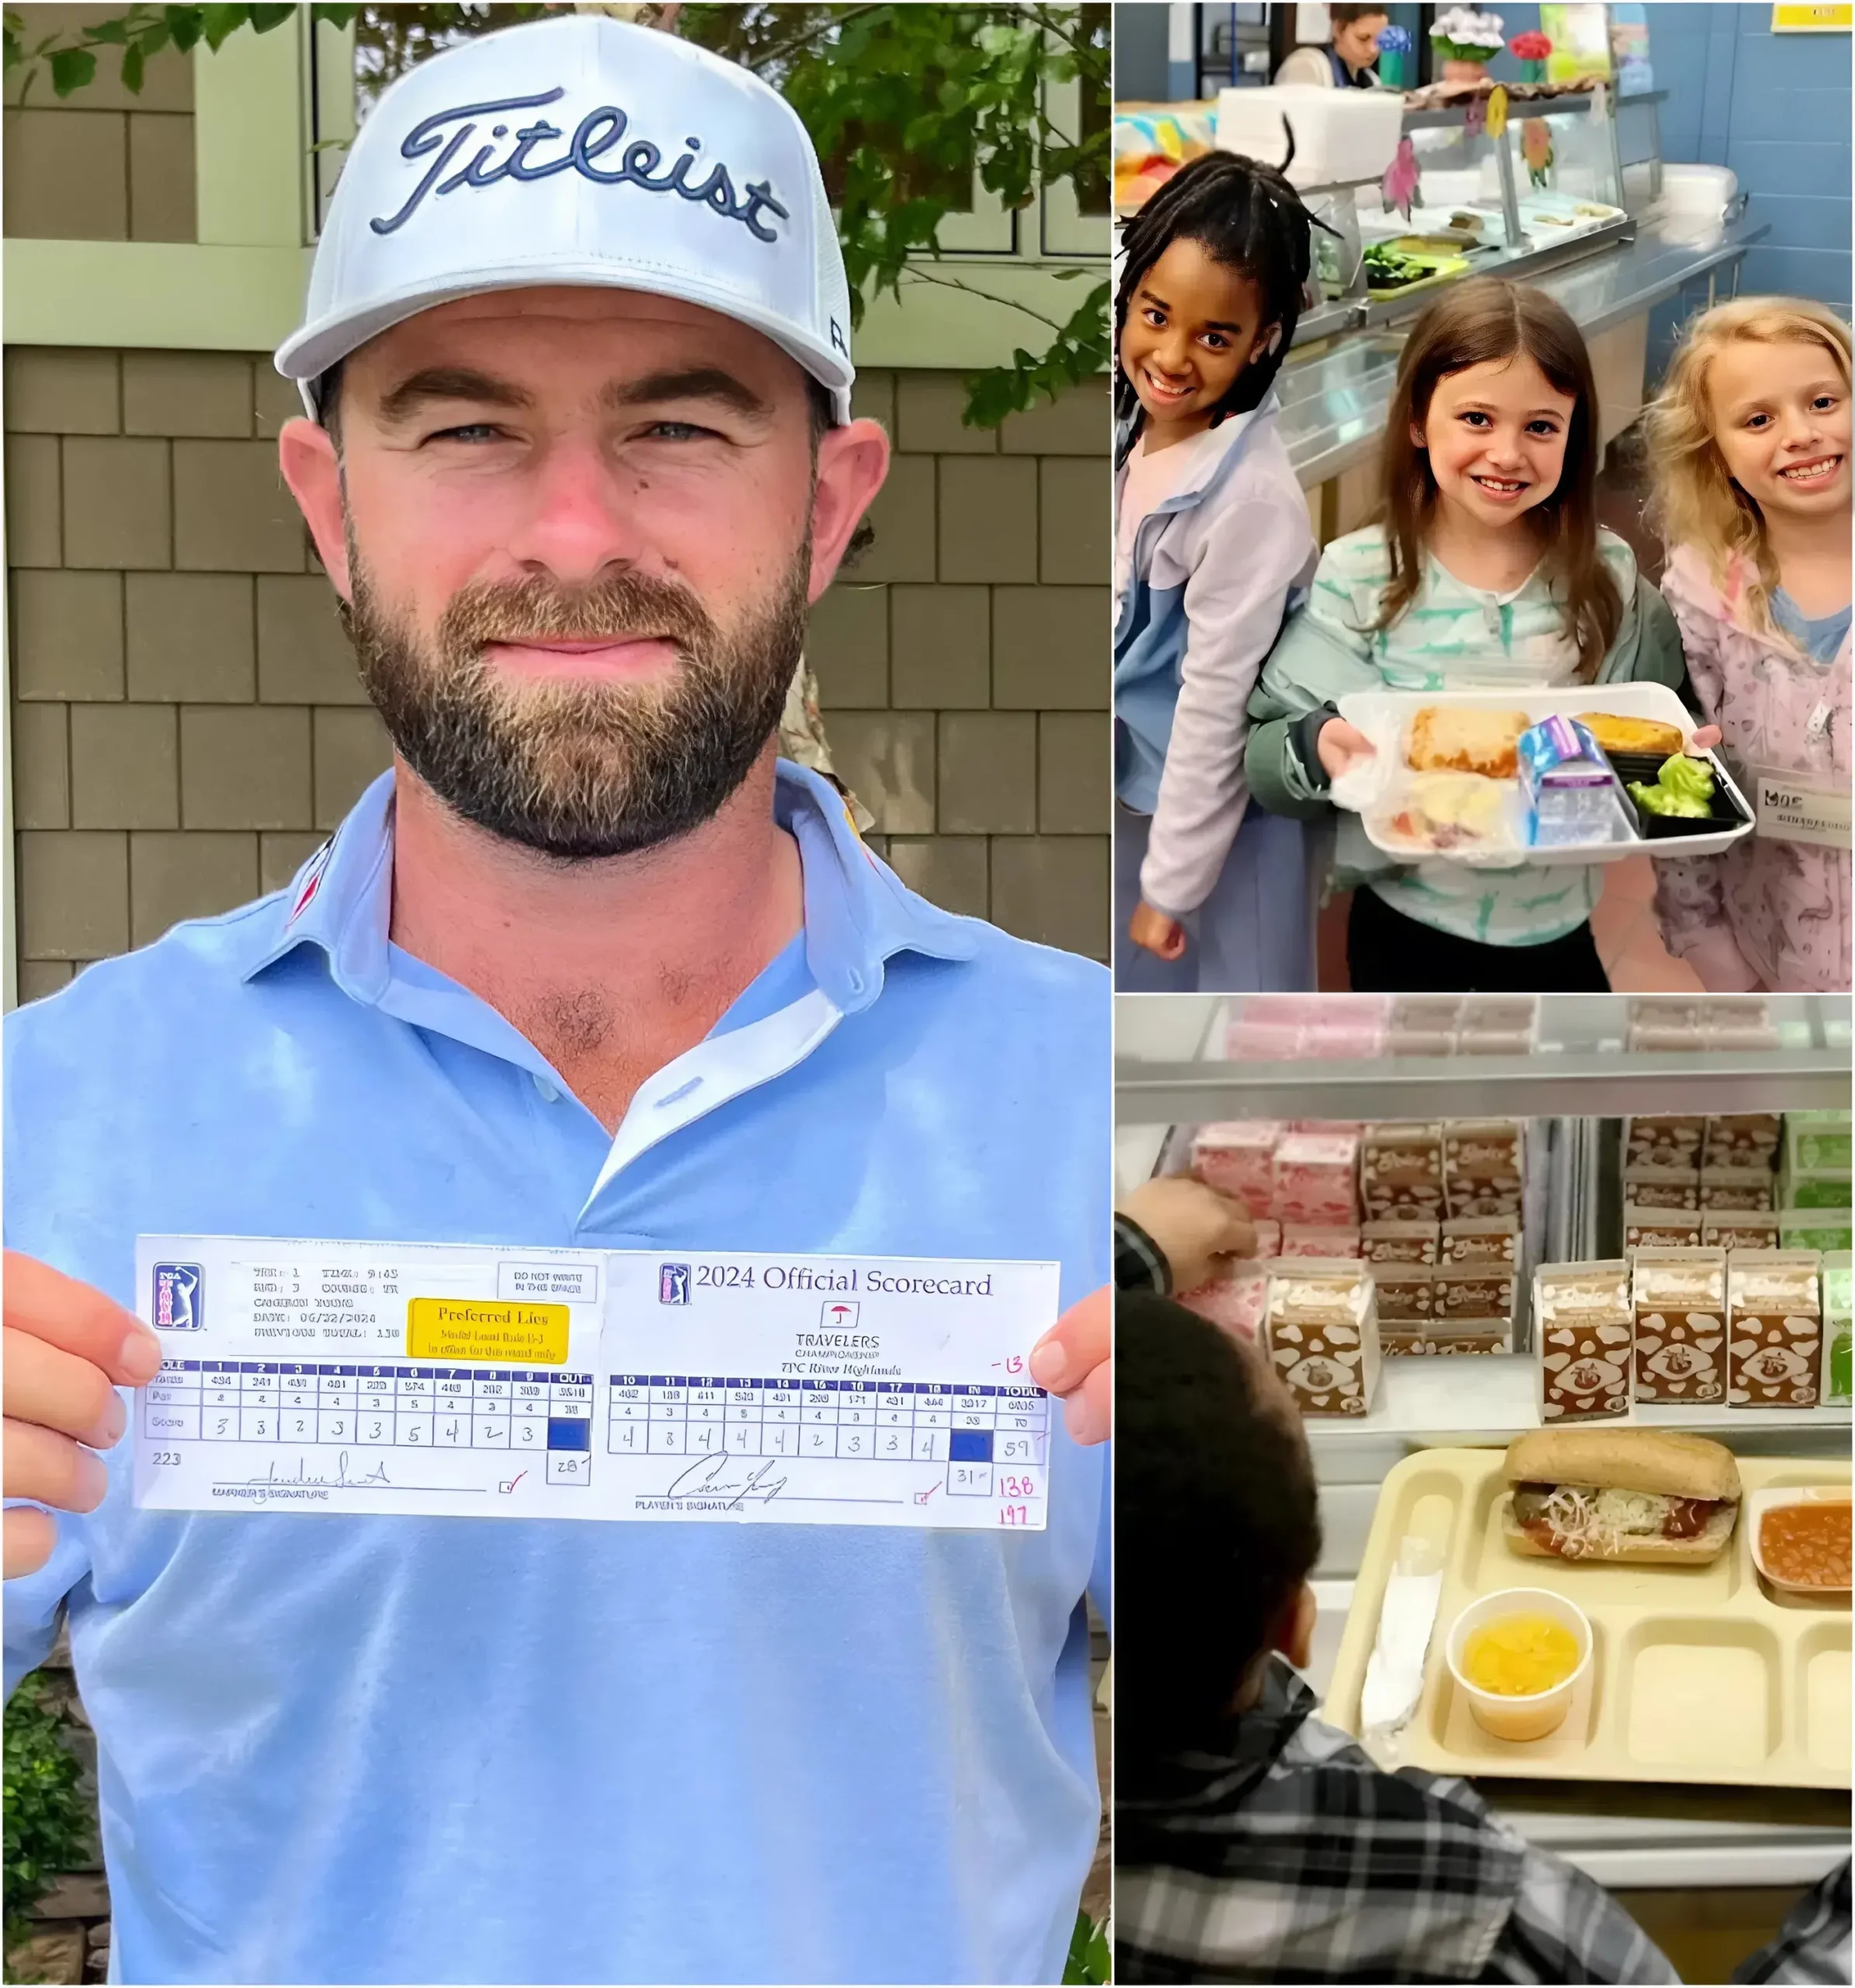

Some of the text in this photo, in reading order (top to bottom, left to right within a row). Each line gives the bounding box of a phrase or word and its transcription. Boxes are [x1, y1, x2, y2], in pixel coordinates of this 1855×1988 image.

[370, 85, 790, 244] Titleist
[696, 1266, 755, 1288] 2024
[763, 1267, 857, 1291] Official
[867, 1271, 993, 1297] Scorecard
[438, 1307, 511, 1323] Preferred
[796, 1334, 880, 1349] TRAVELERS
[217, 1362, 223, 1372] 1
[258, 1364, 266, 1373] 2
[447, 1370, 456, 1379] 7
[665, 1377, 676, 1386] 11
[890, 1383, 903, 1392] 17
[217, 1418, 230, 1435] 3
[257, 1420, 266, 1435] 3
[296, 1420, 304, 1432] 2
[369, 1422, 382, 1439] 3
[408, 1427, 421, 1442] 5
[446, 1420, 460, 1443] 4
[485, 1426, 504, 1438] 2
[523, 1427, 533, 1442] 3
[623, 1426, 634, 1448] 4
[698, 1428, 712, 1450] 4
[737, 1429, 747, 1449] 4
[775, 1430, 786, 1453] 4
[813, 1434, 824, 1446] 2
[848, 1437, 861, 1452] 3
[886, 1435, 899, 1451] 3
[1004, 1441, 1030, 1457] 59
[152, 1453, 182, 1465] 223
[1000, 1476, 1034, 1497] 138
